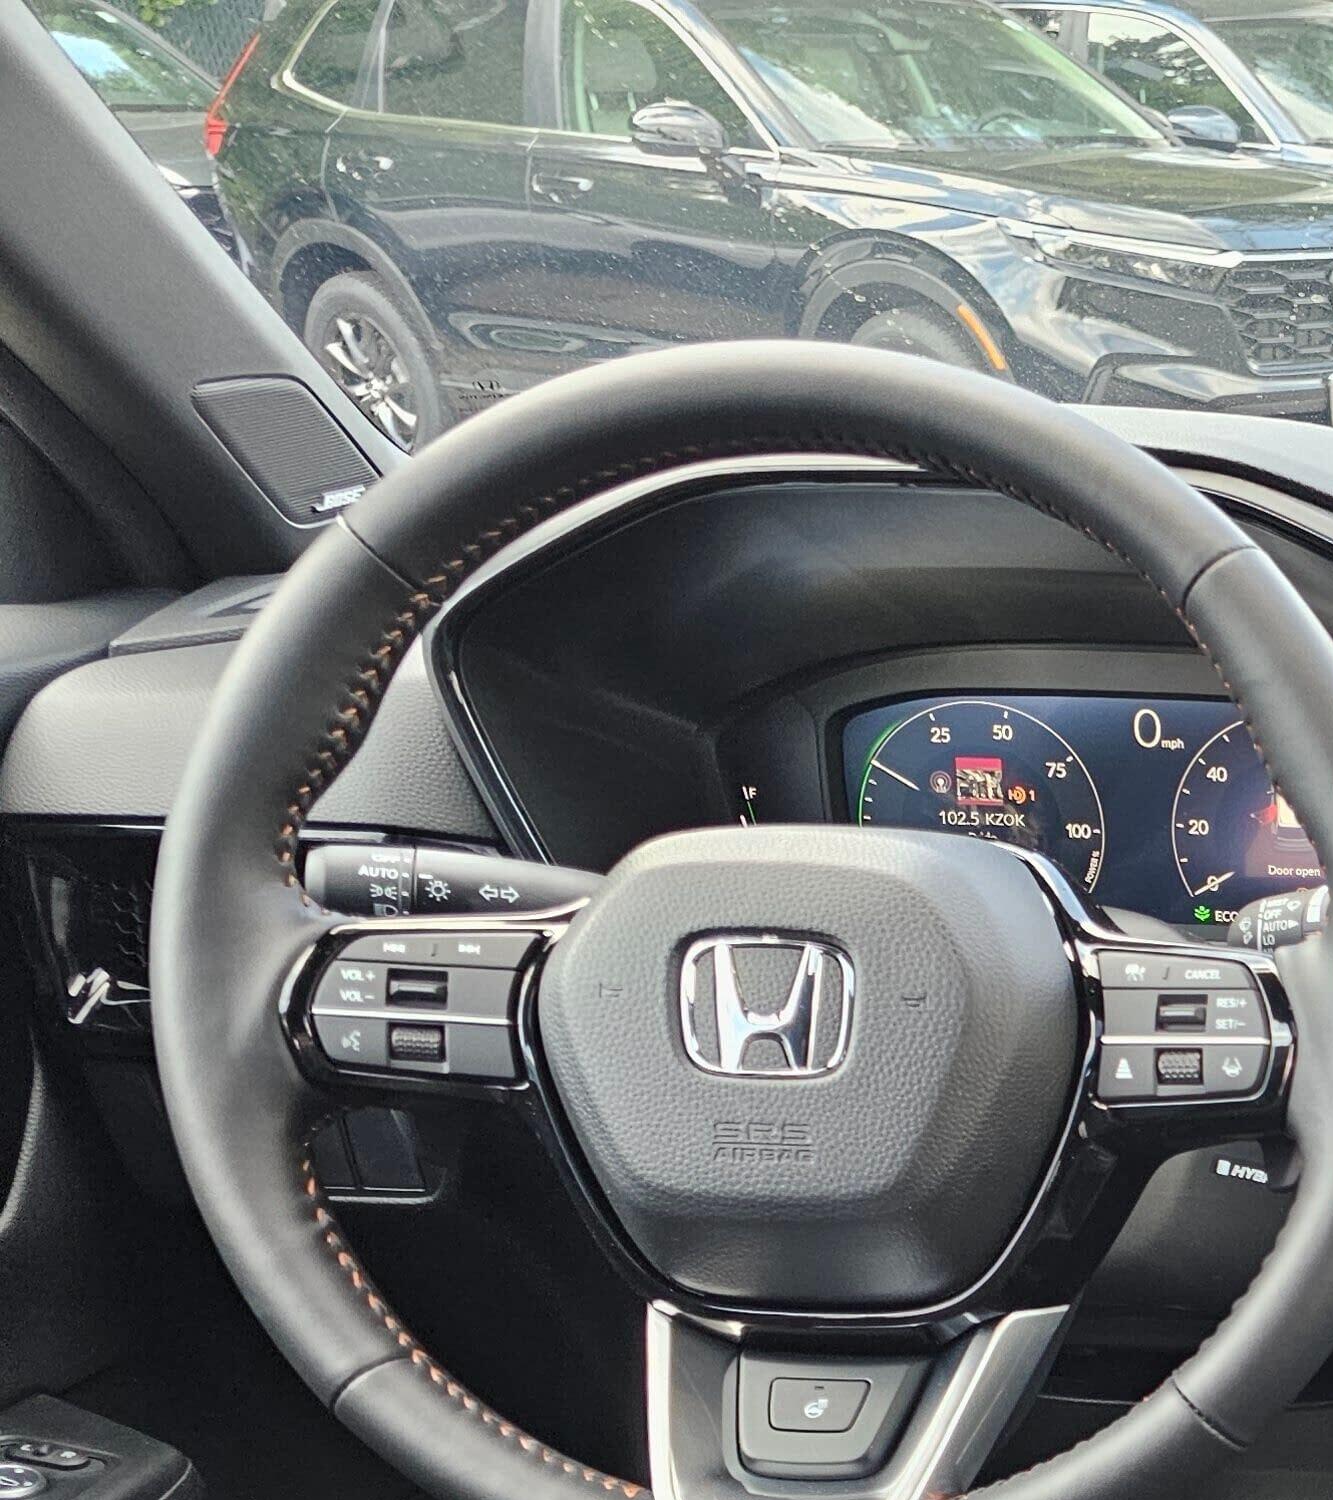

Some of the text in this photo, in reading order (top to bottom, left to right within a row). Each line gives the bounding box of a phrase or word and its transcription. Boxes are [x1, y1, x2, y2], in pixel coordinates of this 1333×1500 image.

[929, 727, 951, 744] 25
[992, 724, 1013, 741] 50
[1133, 708, 1162, 749] 0
[1161, 738, 1185, 750] mph
[1045, 761, 1067, 779] 75
[1206, 766, 1228, 783] 40
[938, 810, 1026, 827] 102.5 KZOK
[1065, 823, 1091, 839] 100
[1188, 819, 1210, 836] 20
[357, 864, 399, 880] AUTO
[1268, 864, 1321, 878] Door open
[1263, 910, 1283, 921] OFF
[1262, 920, 1288, 932] AUTO
[1263, 935, 1276, 946] LO
[340, 969, 364, 982] VOL
[1184, 968, 1221, 981] CANCEL
[340, 990, 364, 1003] VOL
